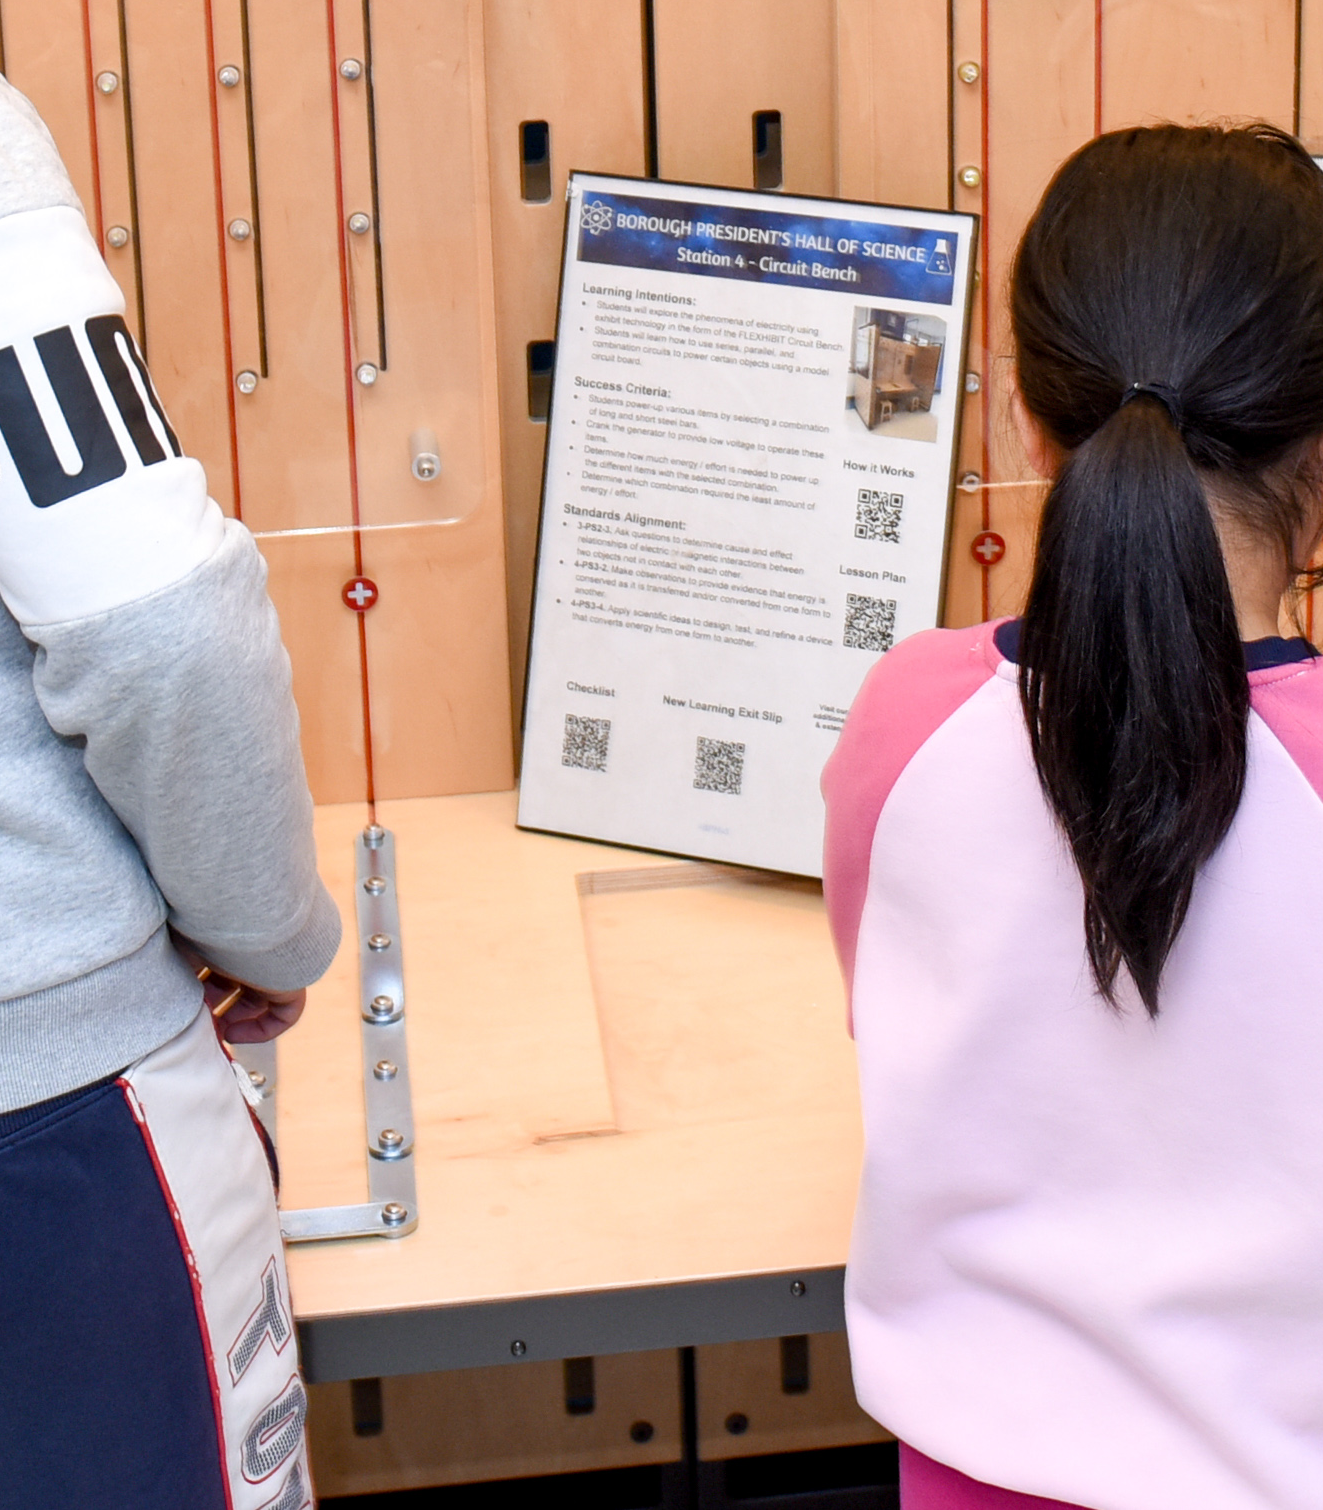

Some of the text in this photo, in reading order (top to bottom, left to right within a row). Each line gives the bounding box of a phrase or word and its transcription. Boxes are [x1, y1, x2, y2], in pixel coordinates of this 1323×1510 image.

[617, 213, 926, 263] BOROUGH PRESIDENT'S HALL OF SCIENCE
[677, 247, 730, 266] Station
[735, 255, 745, 268] 4
[759, 257, 808, 276] Circuit
[812, 263, 857, 281] Bench
[583, 282, 698, 306] Learning Intentions:
[595, 315, 621, 324] exhibit
[622, 317, 666, 331] technology
[677, 324, 691, 333] the
[693, 325, 712, 334] form
[724, 330, 737, 338] the
[738, 331, 785, 344] FLEXHIBIT
[788, 337, 814, 348] Circuit
[597, 300, 632, 313] Students
[634, 306, 647, 314] will
[649, 309, 679, 318] explore
[680, 312, 694, 320] the
[695, 314, 744, 326] phenomena
[756, 322, 795, 334] electricity
[797, 328, 819, 337] using
[591, 353, 615, 362] circuit
[593, 341, 641, 352] combination
[643, 347, 671, 356] circuits
[683, 352, 708, 360] power
[710, 355, 738, 364] certain
[739, 359, 770, 368] objects
[772, 364, 793, 373] using
[803, 367, 829, 376] model
[595, 326, 630, 338] Students
[646, 333, 667, 342] learn
[669, 336, 686, 345] how
[779, 351, 795, 359] and
[574, 376, 674, 399] Success Criteria:
[589, 394, 624, 406] Students
[625, 401, 664, 412] power-up
[666, 406, 696, 416] various
[697, 409, 719, 419] items
[733, 415, 769, 427] selecting
[779, 421, 830, 433] combination
[586, 420, 610, 430] Crank
[612, 424, 625, 432] the
[627, 427, 666, 437] generator
[678, 434, 707, 443] provide
[709, 437, 724, 445] low
[726, 440, 756, 451] voltage
[767, 445, 800, 456] operate
[802, 449, 825, 459] these
[584, 445, 626, 458] Determine
[627, 452, 644, 461] how
[646, 455, 669, 463] much
[670, 459, 698, 470] energy
[705, 462, 727, 472] effort
[737, 468, 768, 478] needed
[780, 474, 806, 482] power
[585, 459, 598, 467] the
[599, 461, 632, 472] different
[634, 466, 657, 475] items
[658, 470, 675, 478] with
[676, 472, 690, 480] the
[691, 474, 726, 485] selected
[843, 459, 915, 478] How it Works
[582, 470, 623, 484] Determine
[625, 478, 649, 487] which
[650, 482, 699, 494] combination
[701, 489, 735, 500] required
[736, 493, 750, 502] the
[752, 496, 772, 505] least
[773, 499, 805, 509] amount
[564, 503, 688, 531] Standards Alignment:
[578, 536, 628, 549] relationships
[640, 545, 669, 555] electric
[720, 557, 767, 570] interactions
[769, 563, 804, 574] between
[614, 527, 630, 537] Ask
[631, 531, 671, 543] questions
[682, 538, 723, 550] determine
[724, 545, 750, 554] cause
[752, 548, 768, 556] and
[769, 550, 793, 560] effect
[611, 565, 634, 576] Make
[635, 570, 687, 584] observations
[698, 580, 729, 590] provide
[731, 585, 768, 596] evidence
[769, 589, 786, 599] that
[787, 593, 816, 605] energy
[839, 565, 907, 584] Lesson Plan
[607, 605, 631, 617] Apply
[633, 610, 668, 621] scientific
[669, 615, 692, 625] ideas
[755, 628, 770, 637] and
[772, 630, 796, 640] refine
[806, 635, 833, 646] device
[566, 681, 616, 697] Checklist
[663, 695, 783, 725] New Learning Exit Slip
